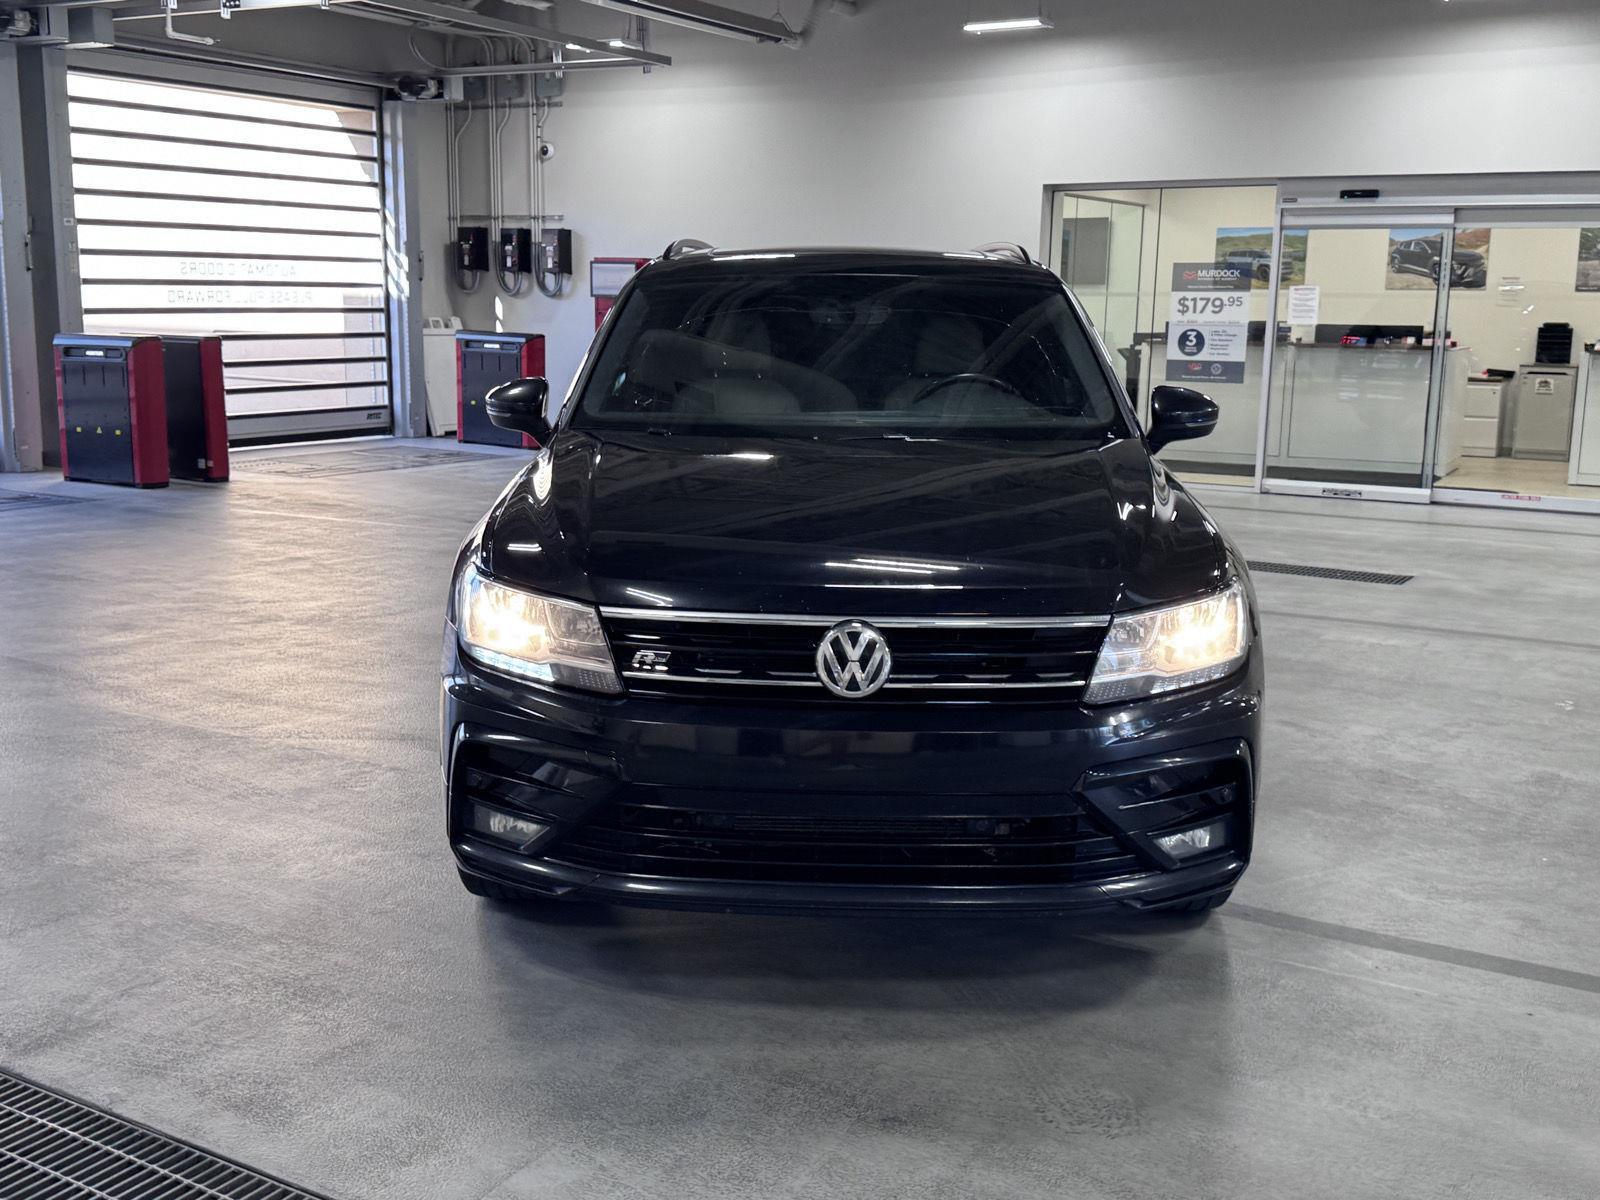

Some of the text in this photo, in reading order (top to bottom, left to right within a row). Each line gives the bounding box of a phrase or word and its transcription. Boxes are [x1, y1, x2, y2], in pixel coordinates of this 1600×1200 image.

[1197, 269, 1241, 278] MURDOCK
[1177, 296, 1243, 316] $179.95
[1185, 331, 1198, 346] 3
[819, 625, 888, 695] VW
